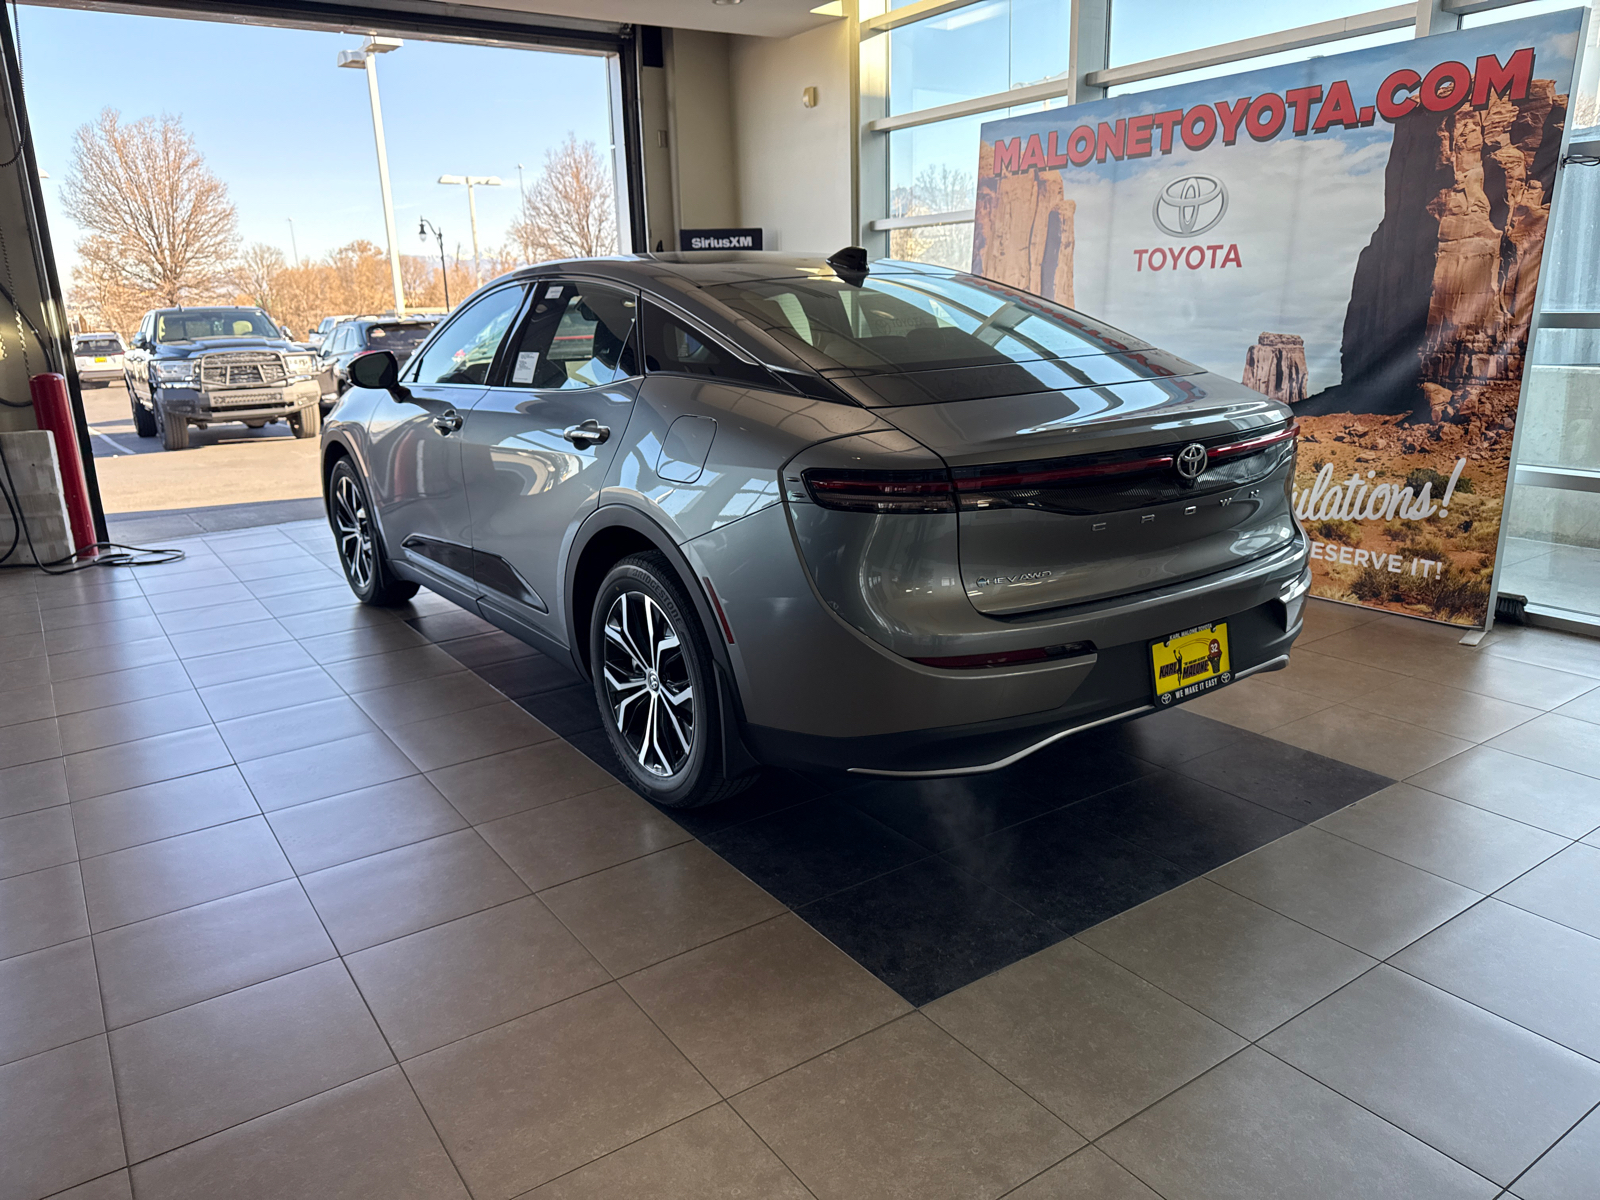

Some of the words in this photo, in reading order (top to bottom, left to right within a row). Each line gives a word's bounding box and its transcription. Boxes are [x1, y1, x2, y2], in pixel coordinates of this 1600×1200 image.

[993, 47, 1536, 176] MALONETOYOTA.COM
[691, 236, 752, 248] SiriusXM
[1133, 244, 1242, 272] TOYOTA
[1293, 458, 1466, 521] ulations!
[1092, 489, 1260, 532] CROWN
[1310, 541, 1403, 573] ESERVE
[1411, 557, 1443, 581] IT!
[1019, 570, 1052, 581] AWD
[631, 568, 684, 626] BRIDGESTONE
[1210, 643, 1219, 653] 32
[1159, 661, 1178, 679] KARL
[1182, 659, 1210, 680] MALONE
[1175, 689, 1184, 699] WE
[1184, 683, 1199, 696] MAKE
[1199, 681, 1205, 690] IT
[1205, 677, 1218, 689] EASY
